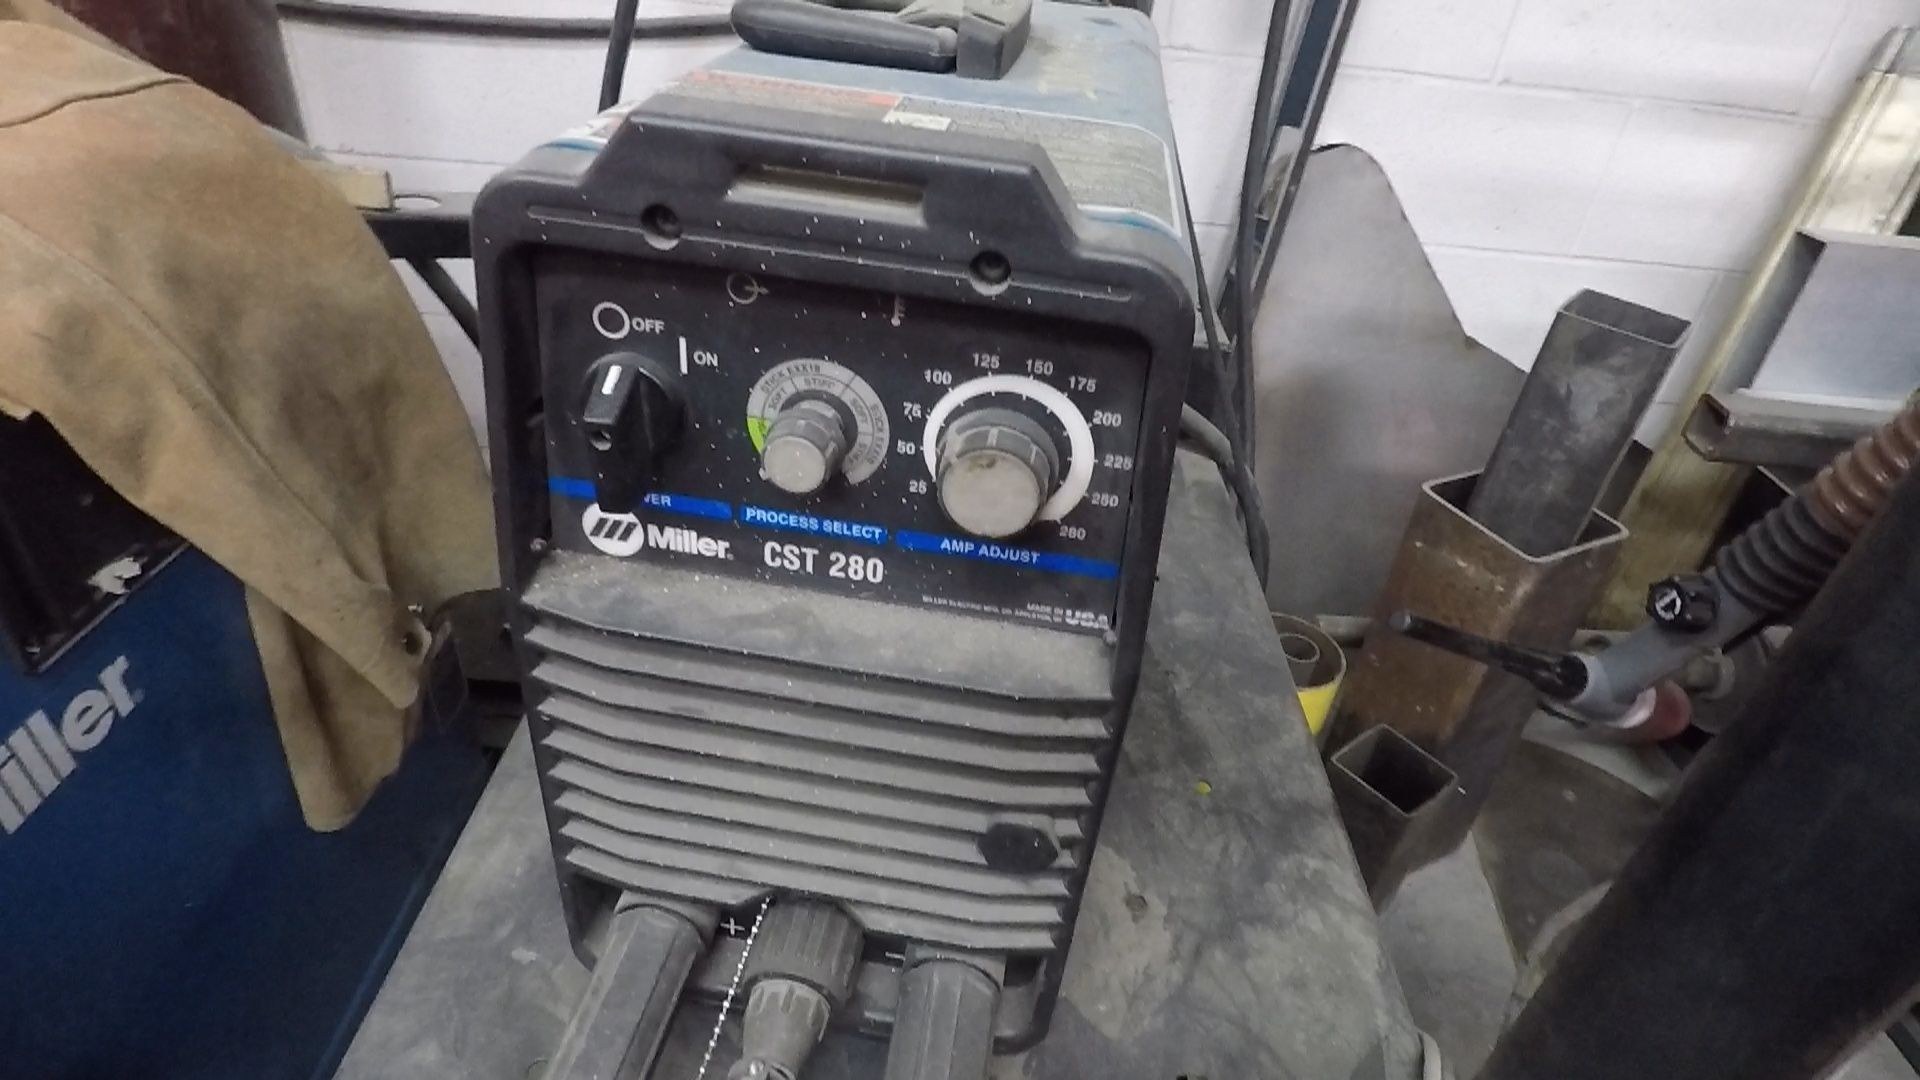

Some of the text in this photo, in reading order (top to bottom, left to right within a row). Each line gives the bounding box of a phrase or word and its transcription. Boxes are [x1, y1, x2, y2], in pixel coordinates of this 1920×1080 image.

[632, 317, 665, 334] OFF
[693, 351, 719, 367] ON
[973, 353, 1000, 370] 125
[1026, 359, 1054, 376] 150
[924, 369, 952, 385] 100
[1068, 376, 1097, 393] 175
[903, 402, 921, 418] 75
[1092, 411, 1122, 428] 200
[897, 440, 915, 454] 50
[1103, 454, 1133, 471] 225
[909, 480, 927, 494] 25
[1091, 492, 1119, 508] 250
[745, 507, 883, 540] PROCESS SELECT
[1059, 525, 1087, 541] 280
[940, 538, 1041, 564] AMP ADJUST
[763, 541, 884, 584] CST 280
